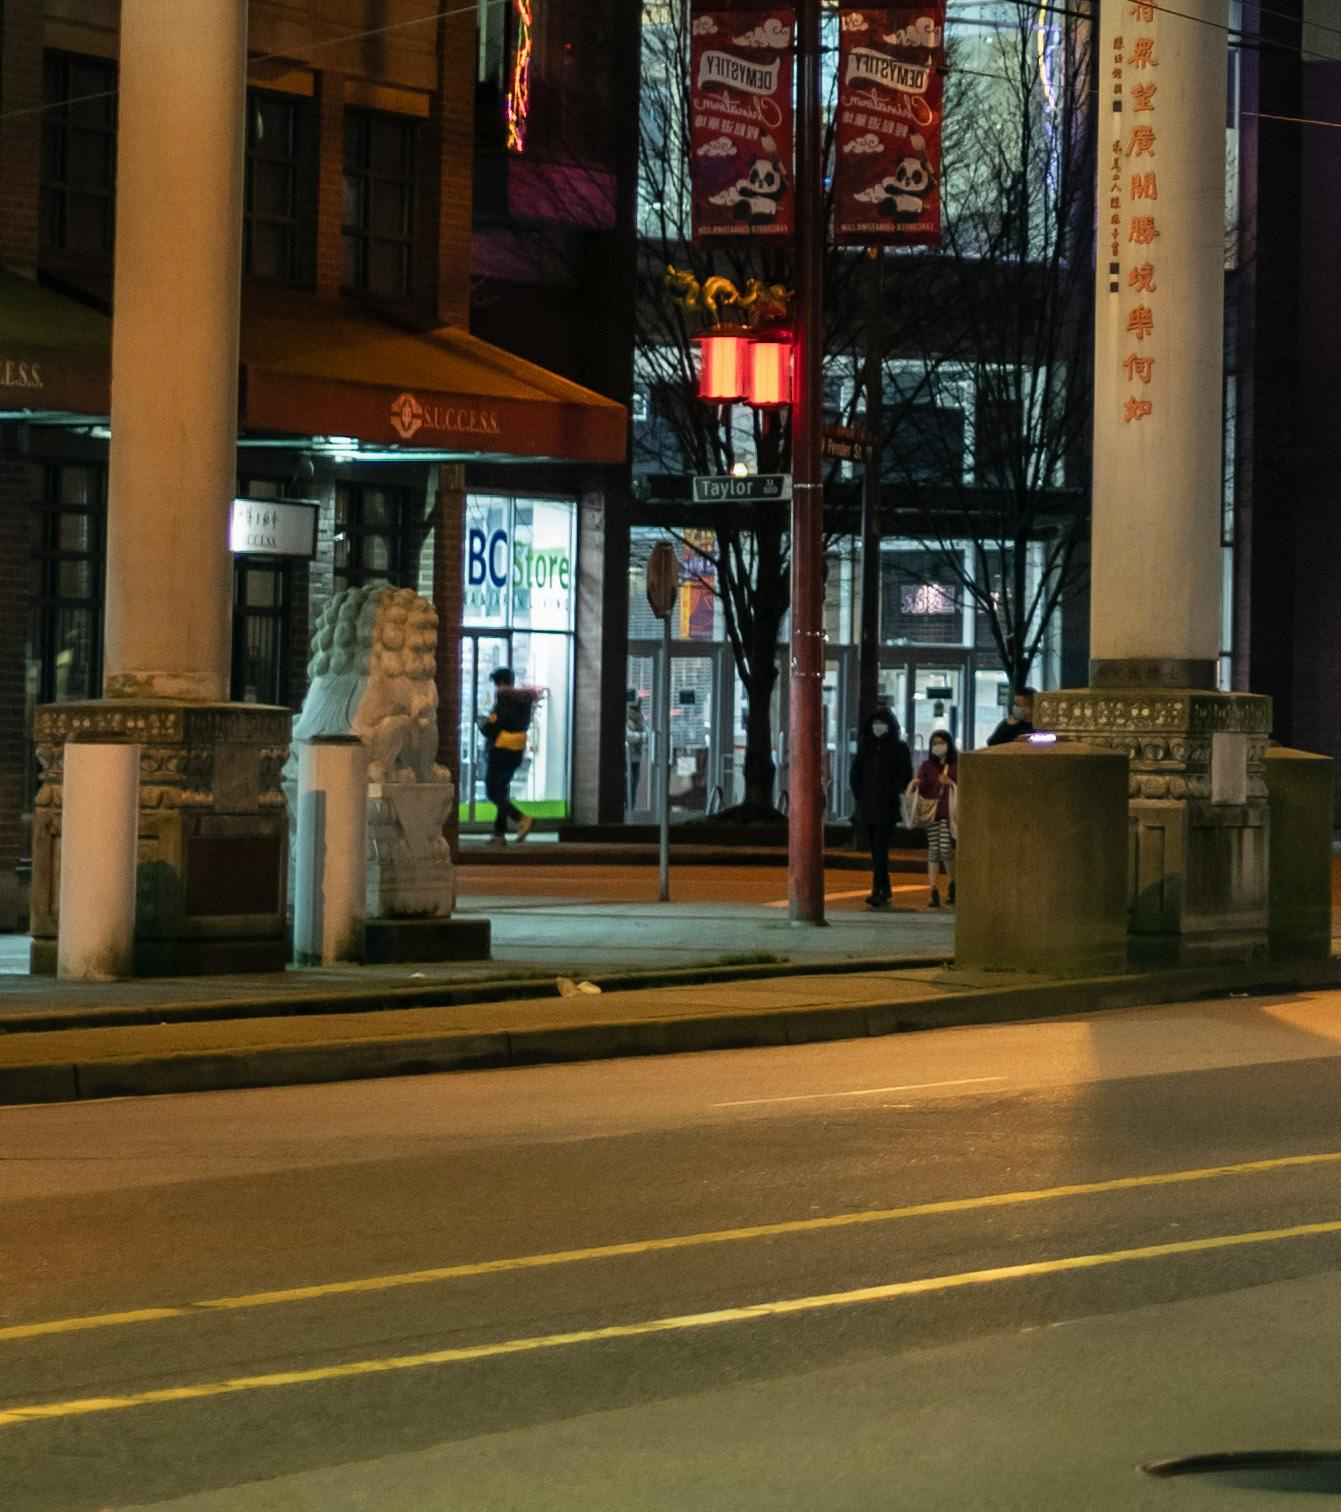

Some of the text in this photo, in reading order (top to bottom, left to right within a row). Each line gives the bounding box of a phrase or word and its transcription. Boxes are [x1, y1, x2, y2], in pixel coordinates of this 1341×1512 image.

[702, 479, 754, 501] Taylor
[468, 527, 570, 590] BC Store
